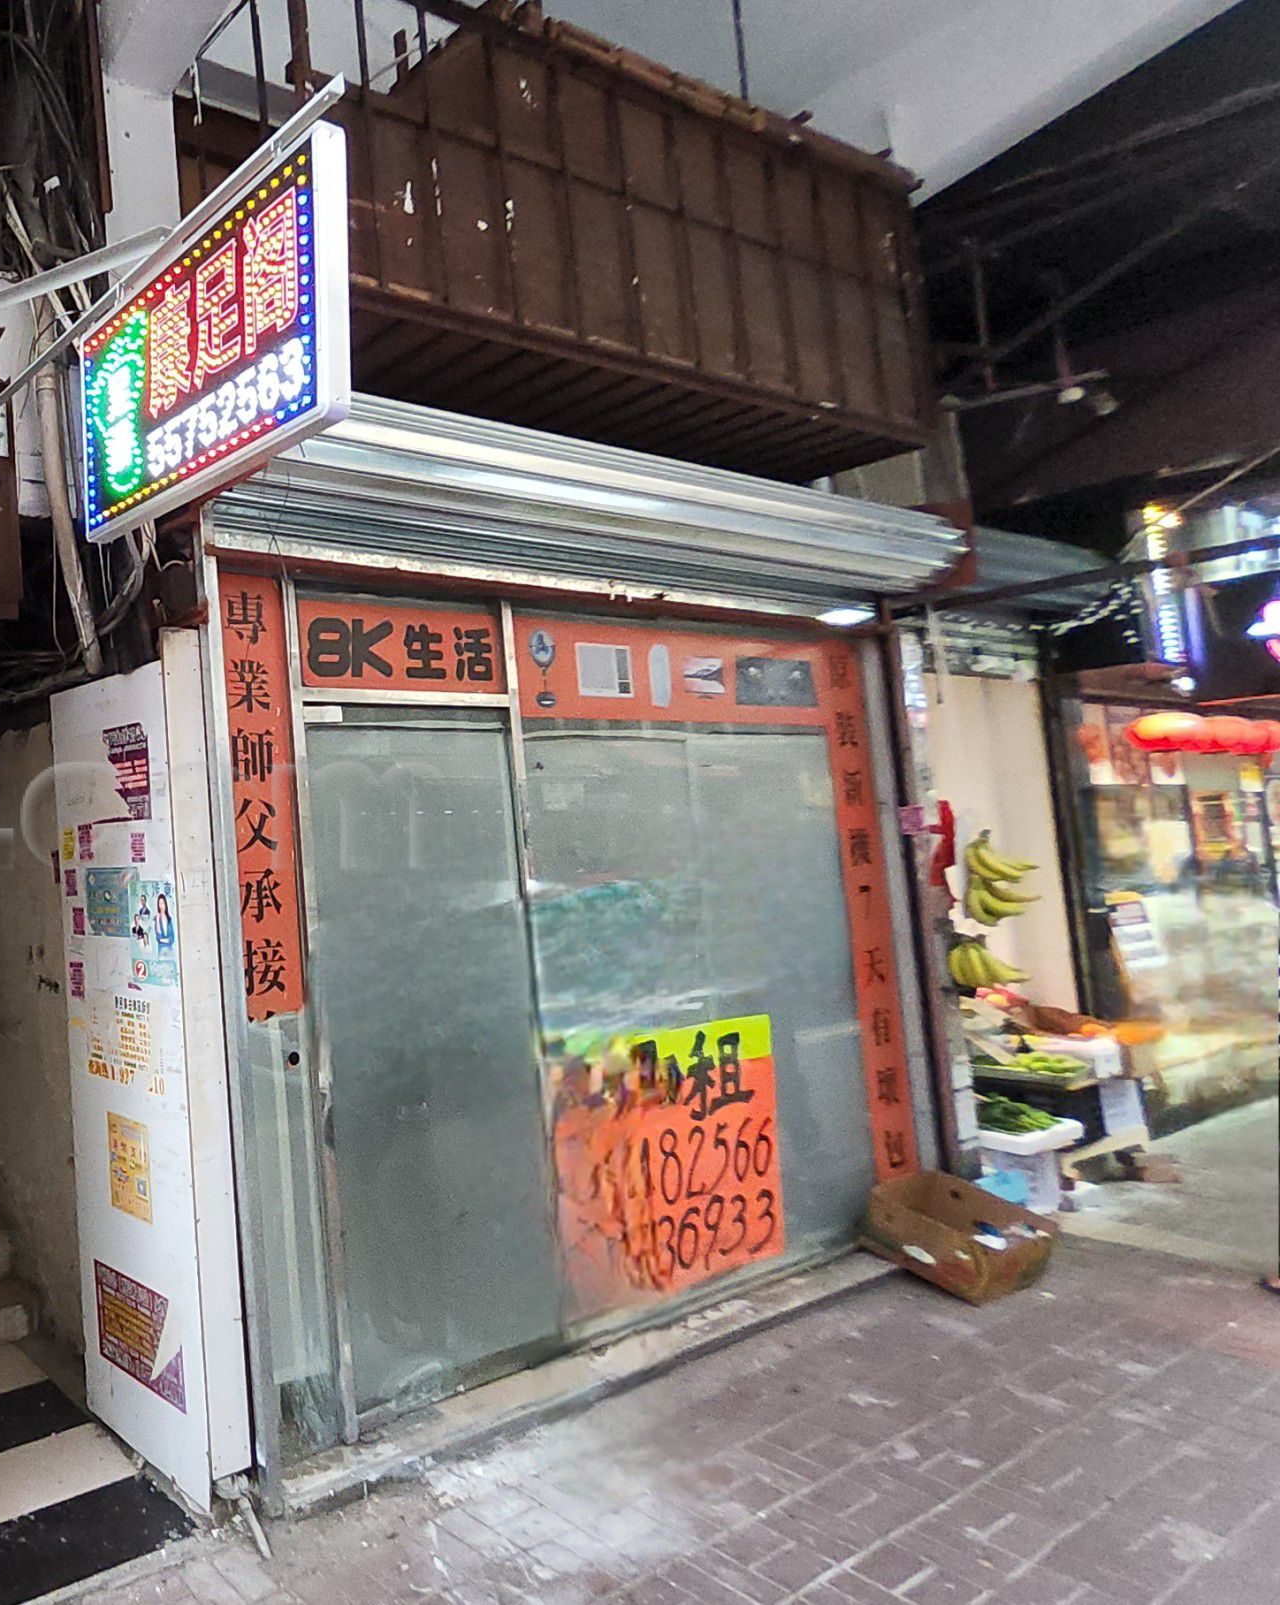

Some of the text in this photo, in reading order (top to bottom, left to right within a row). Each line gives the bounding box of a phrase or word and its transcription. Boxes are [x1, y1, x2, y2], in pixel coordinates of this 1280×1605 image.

[146, 338, 304, 477] 55752563
[225, 591, 286, 1023] 專業師父承接
